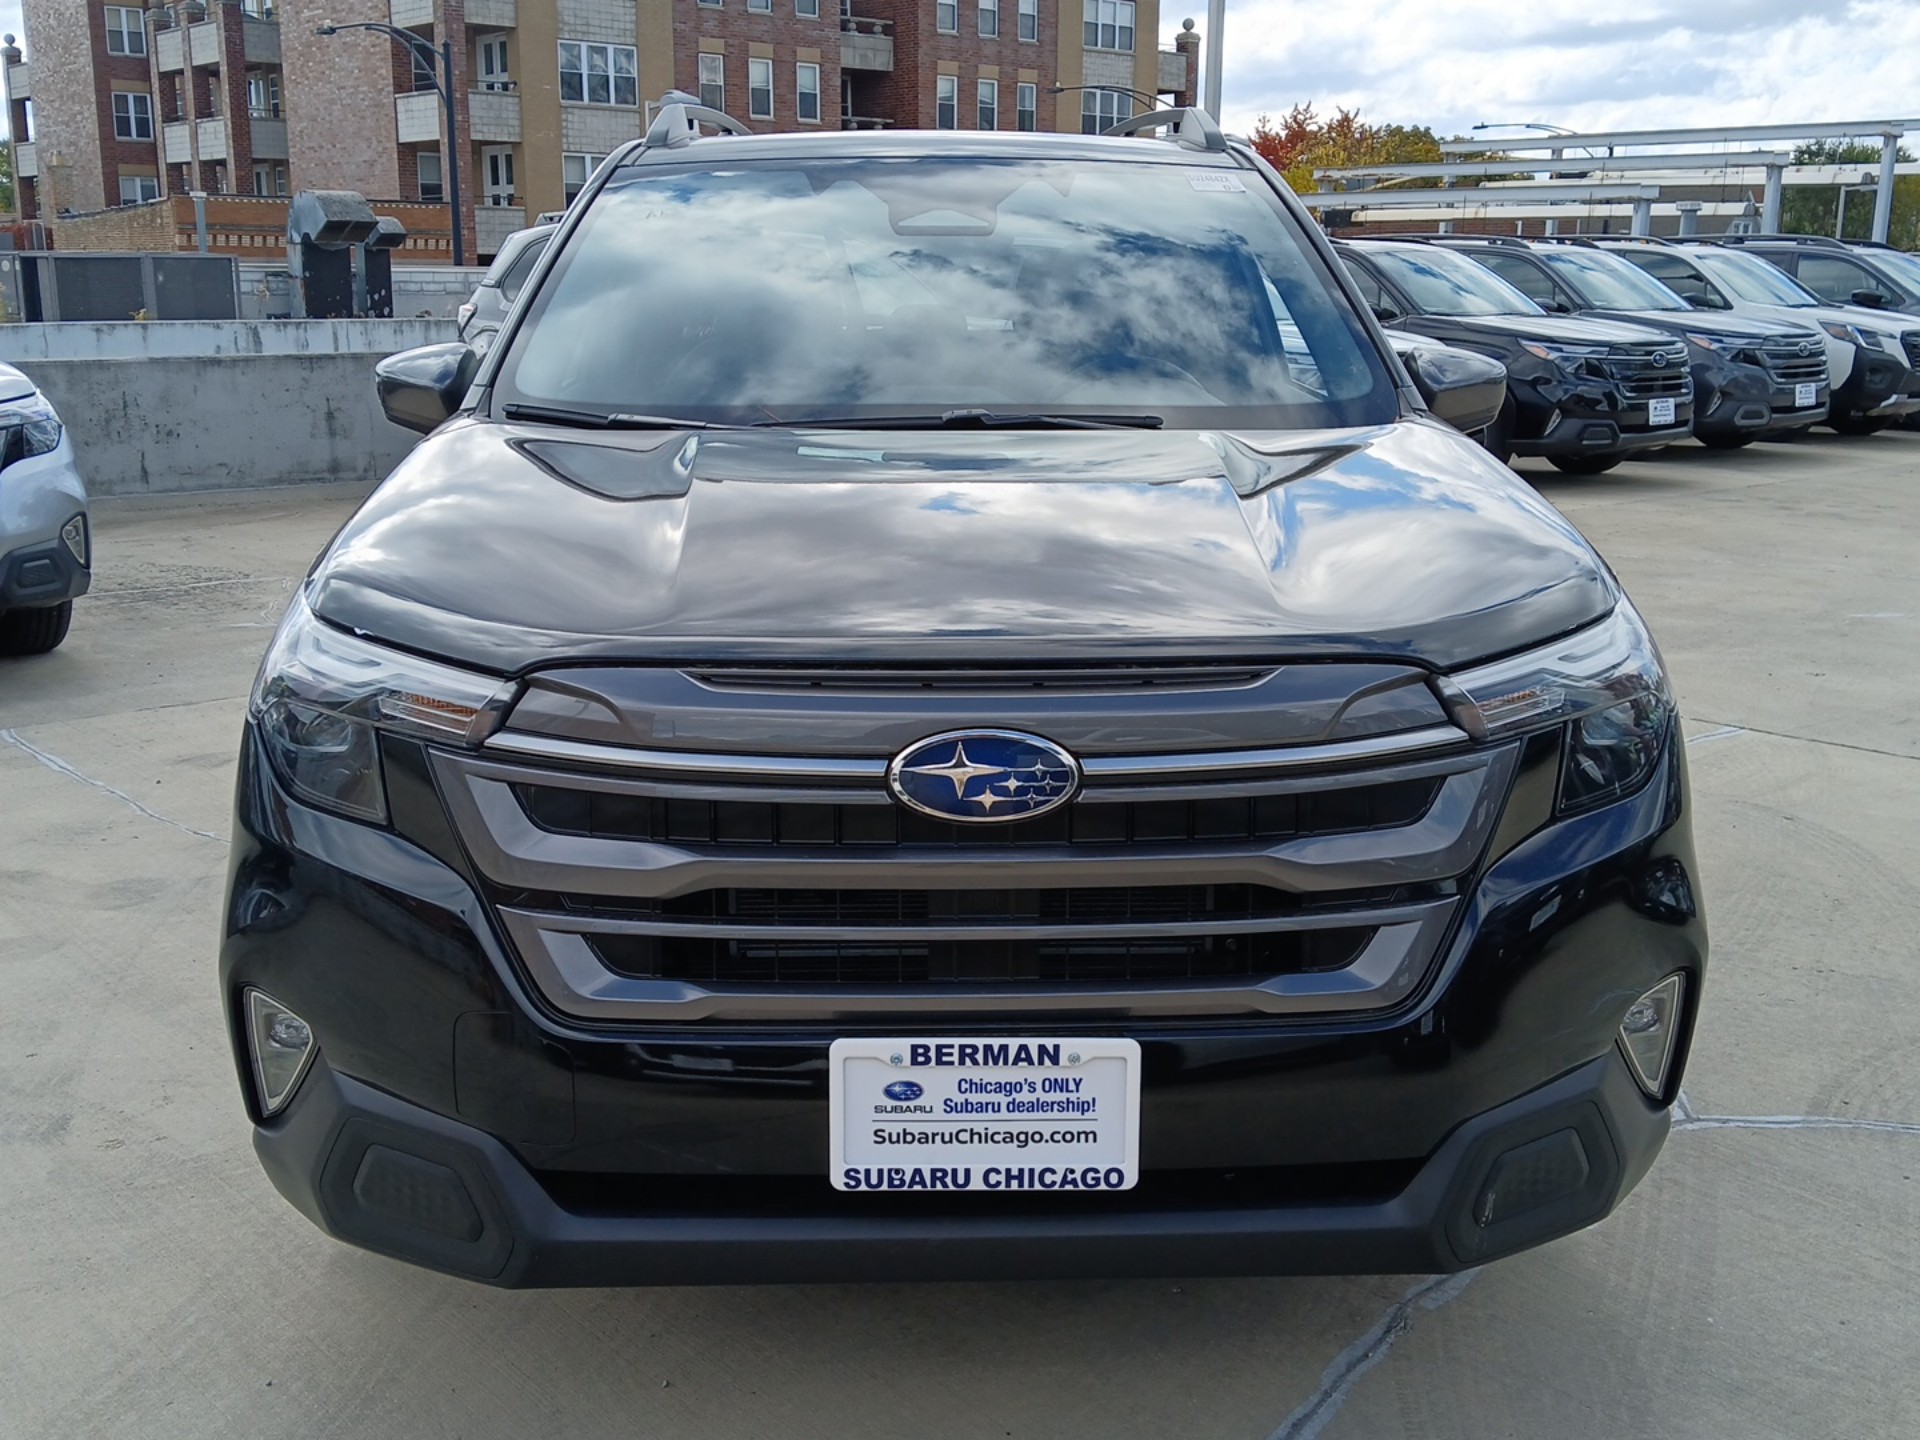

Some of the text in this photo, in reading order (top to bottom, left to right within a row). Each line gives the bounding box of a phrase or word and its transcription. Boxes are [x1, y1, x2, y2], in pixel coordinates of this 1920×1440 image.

[910, 1043, 1061, 1066] BERMAN
[957, 1077, 1083, 1097] Chicago's ONLY
[873, 1104, 933, 1114] SUBARU
[943, 1097, 1097, 1116] Subaru dealership!
[872, 1127, 1098, 1148] SubaruChicago.com
[843, 1167, 971, 1189] SUBARU
[982, 1167, 1125, 1188] CHICAGO
